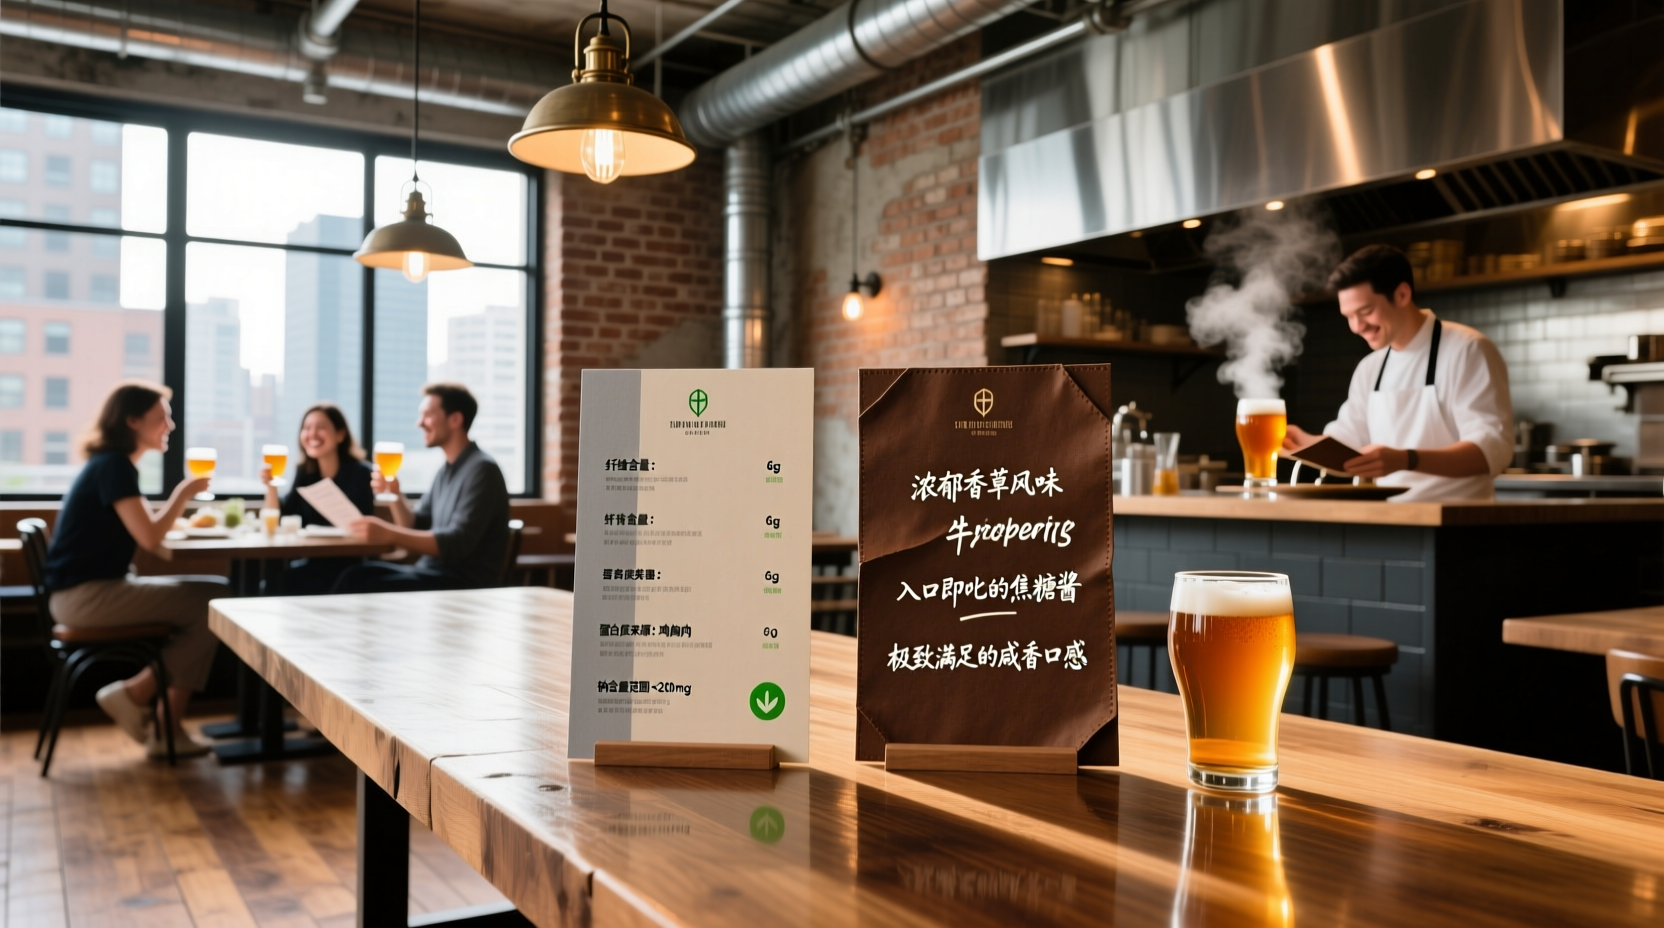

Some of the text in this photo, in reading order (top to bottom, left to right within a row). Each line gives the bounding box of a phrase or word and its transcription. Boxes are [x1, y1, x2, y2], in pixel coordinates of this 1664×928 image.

[910, 467, 1064, 503] 浓郁香草风味
[887, 639, 1088, 672] 极致满足的咸香口感
